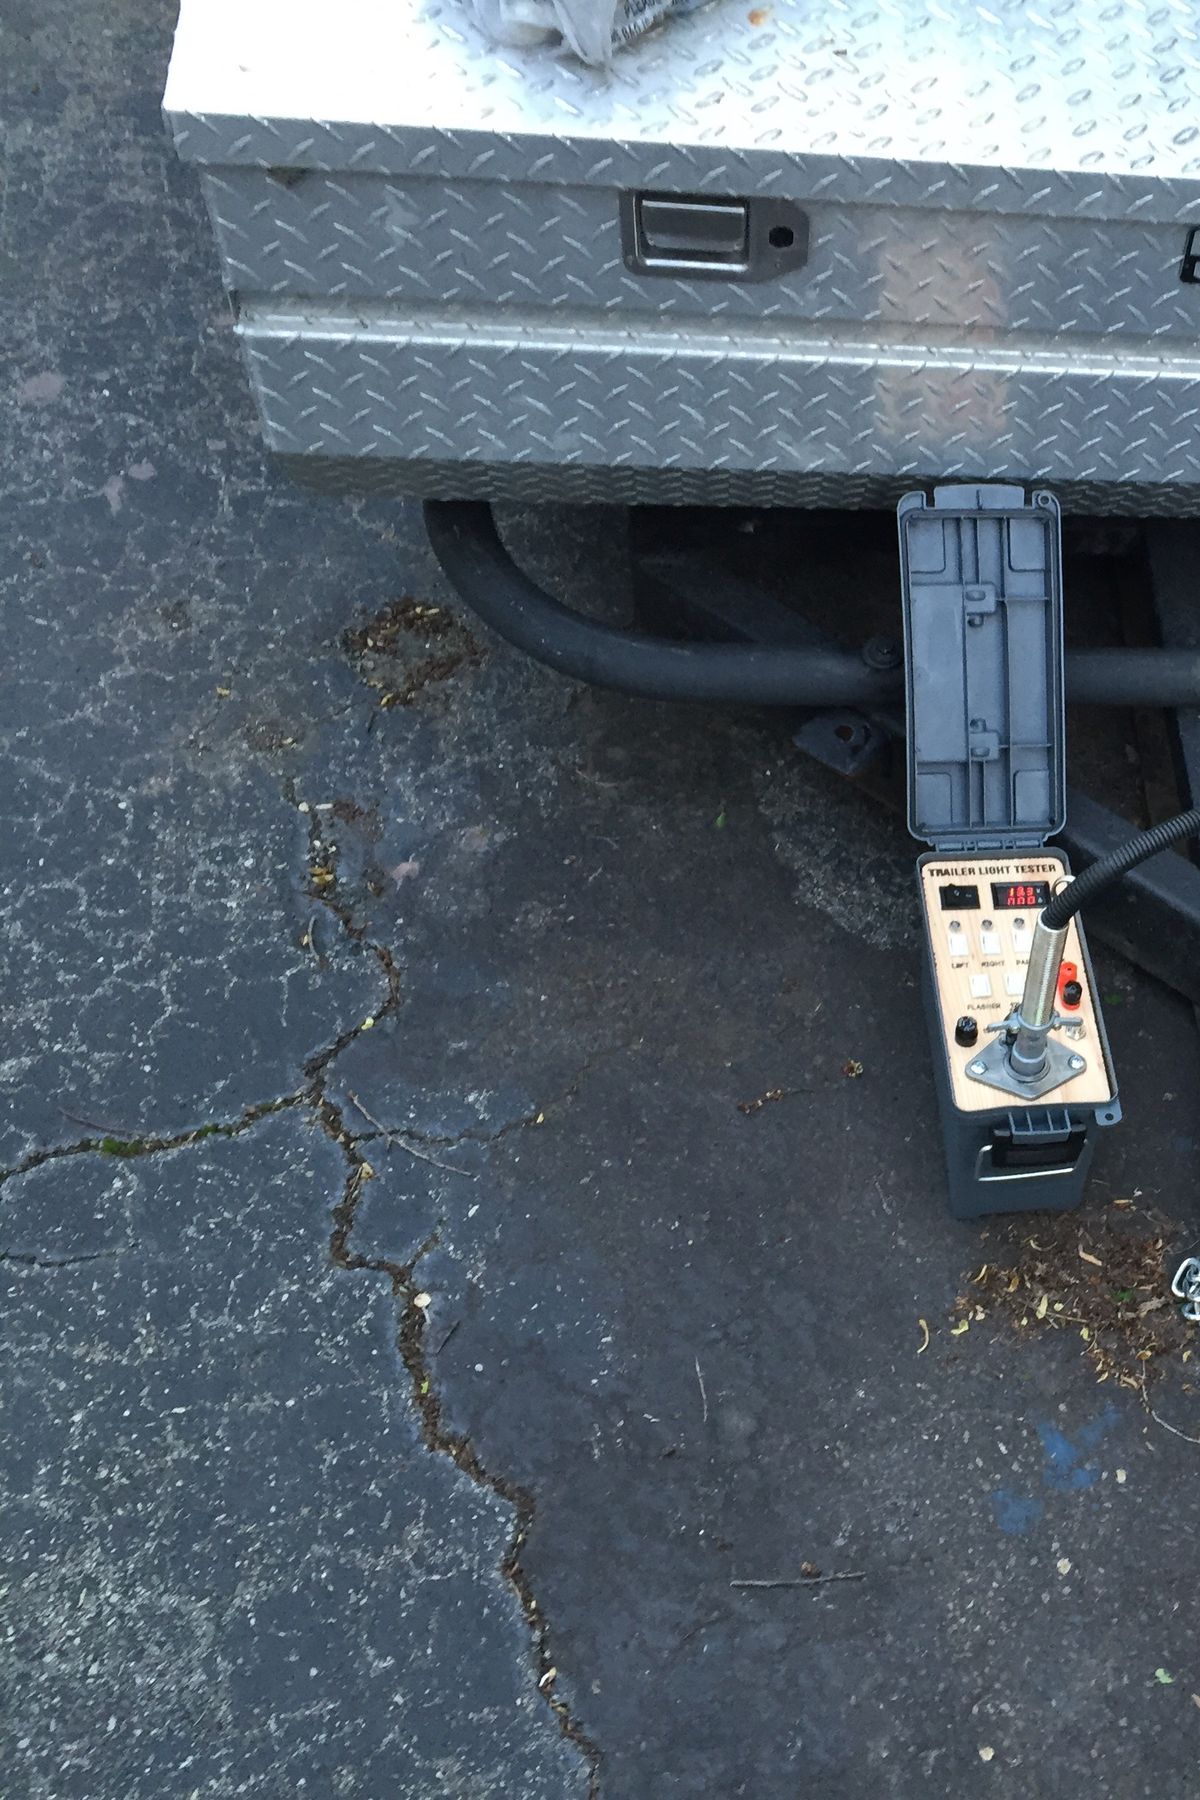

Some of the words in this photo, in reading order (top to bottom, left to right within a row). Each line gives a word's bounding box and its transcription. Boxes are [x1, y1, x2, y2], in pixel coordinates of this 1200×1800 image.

[928, 867, 976, 877] TRAILER
[979, 865, 1012, 875] LIGHT
[1014, 864, 1057, 874] TESTER
